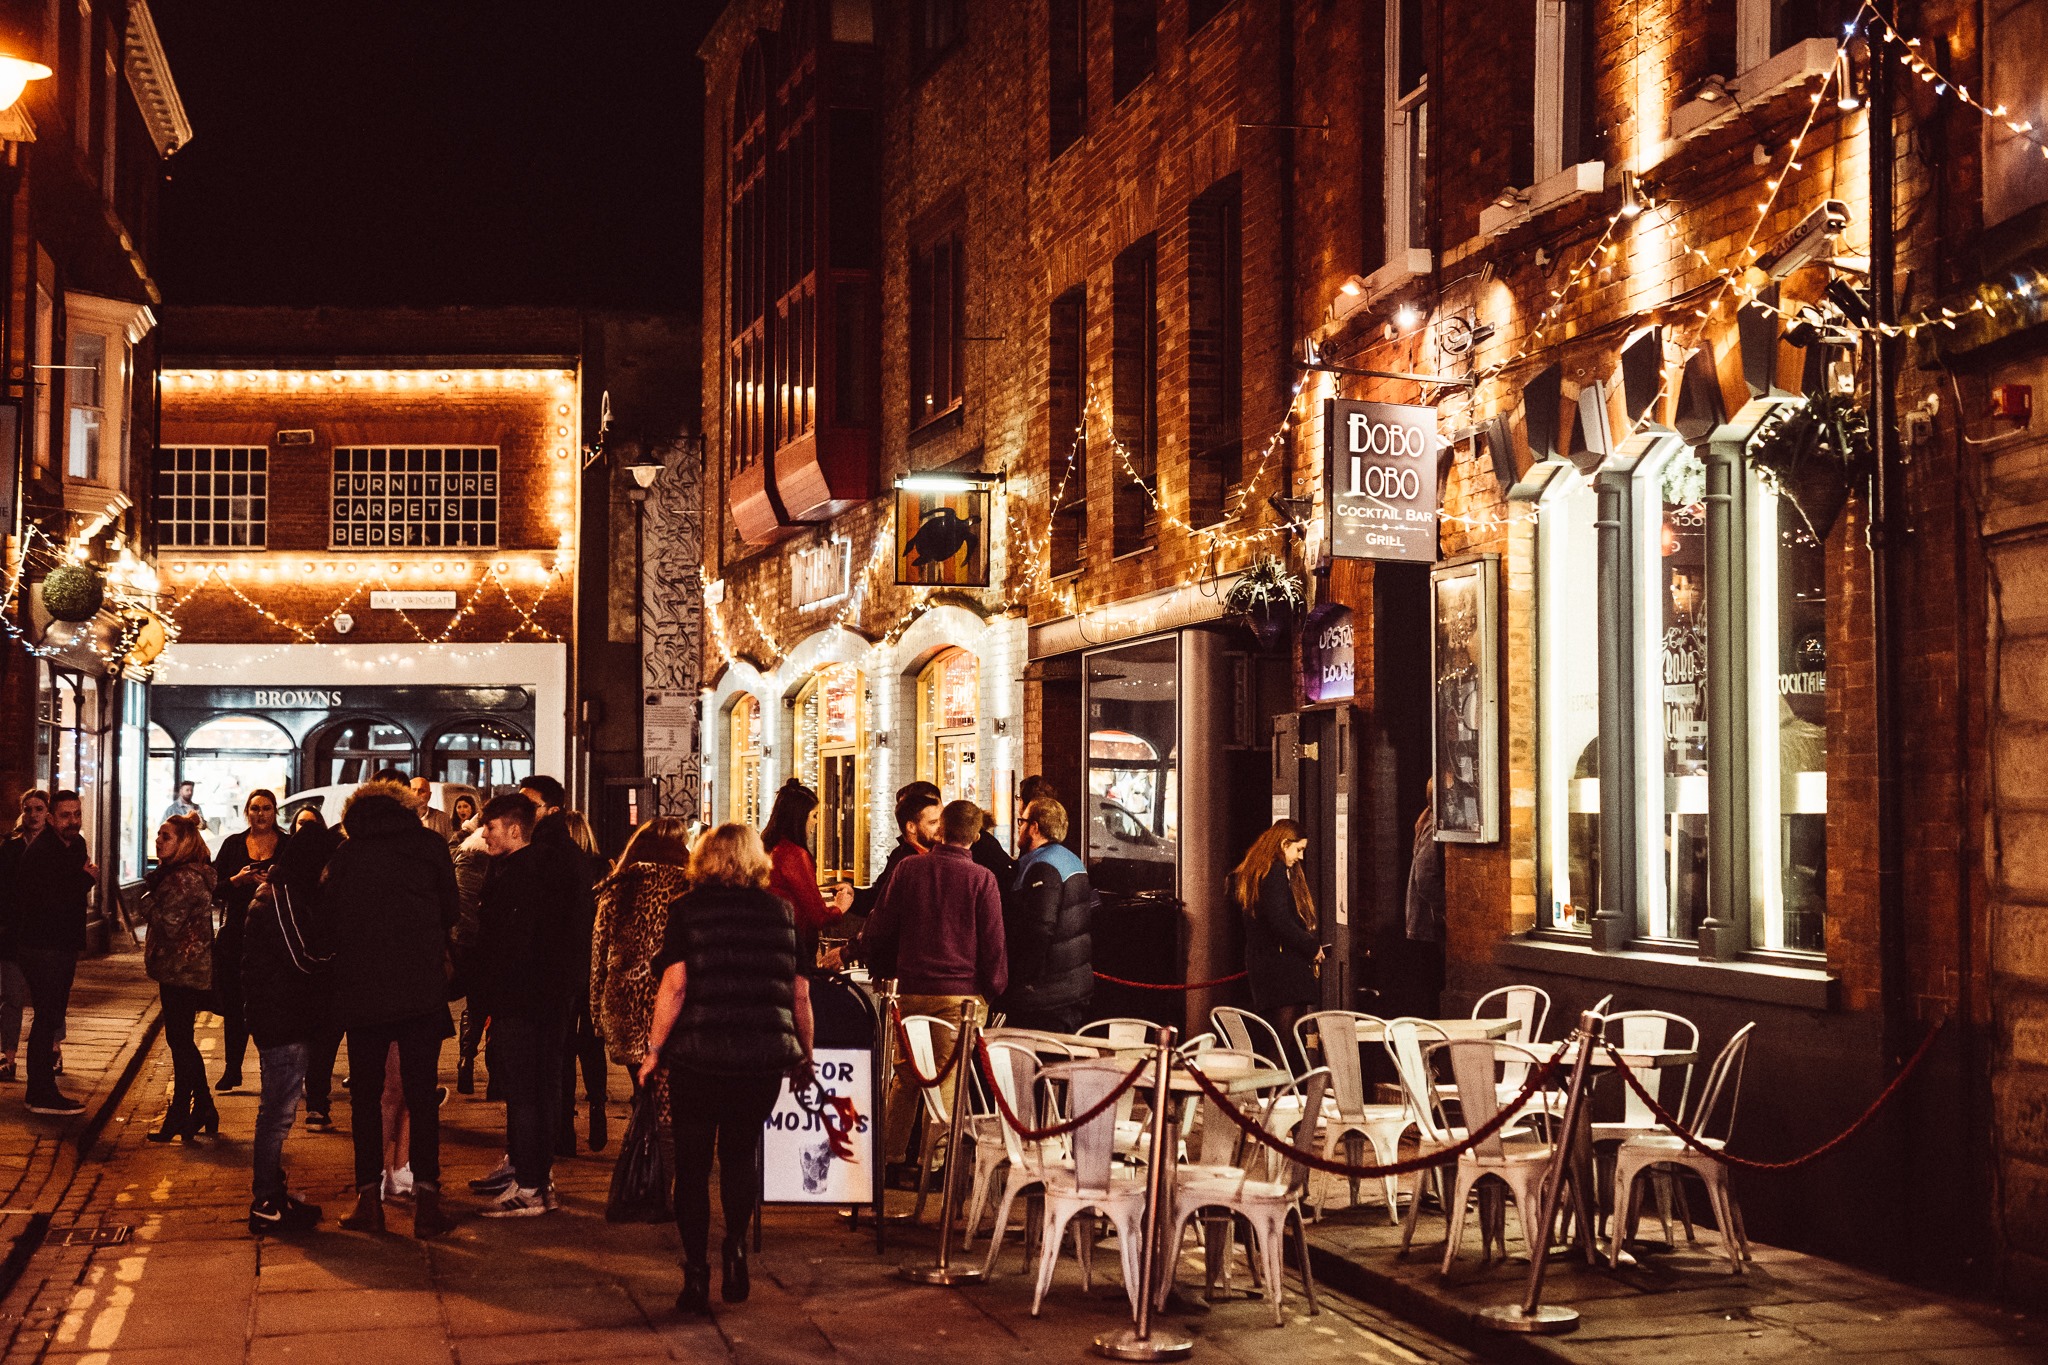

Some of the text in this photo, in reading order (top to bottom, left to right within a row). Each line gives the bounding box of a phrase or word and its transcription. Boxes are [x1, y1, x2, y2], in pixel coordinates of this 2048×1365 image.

[1347, 412, 1425, 458] BOBO
[336, 478, 494, 492] FURNITURE
[1345, 456, 1420, 500] LOBO
[335, 503, 458, 517] CARPETS
[1337, 503, 1433, 523] COCKTAIL BAR
[335, 527, 403, 542] BEDS
[1365, 532, 1405, 547] GRILL
[254, 690, 342, 707] BROWNS
[766, 1111, 869, 1134] MOJITS
